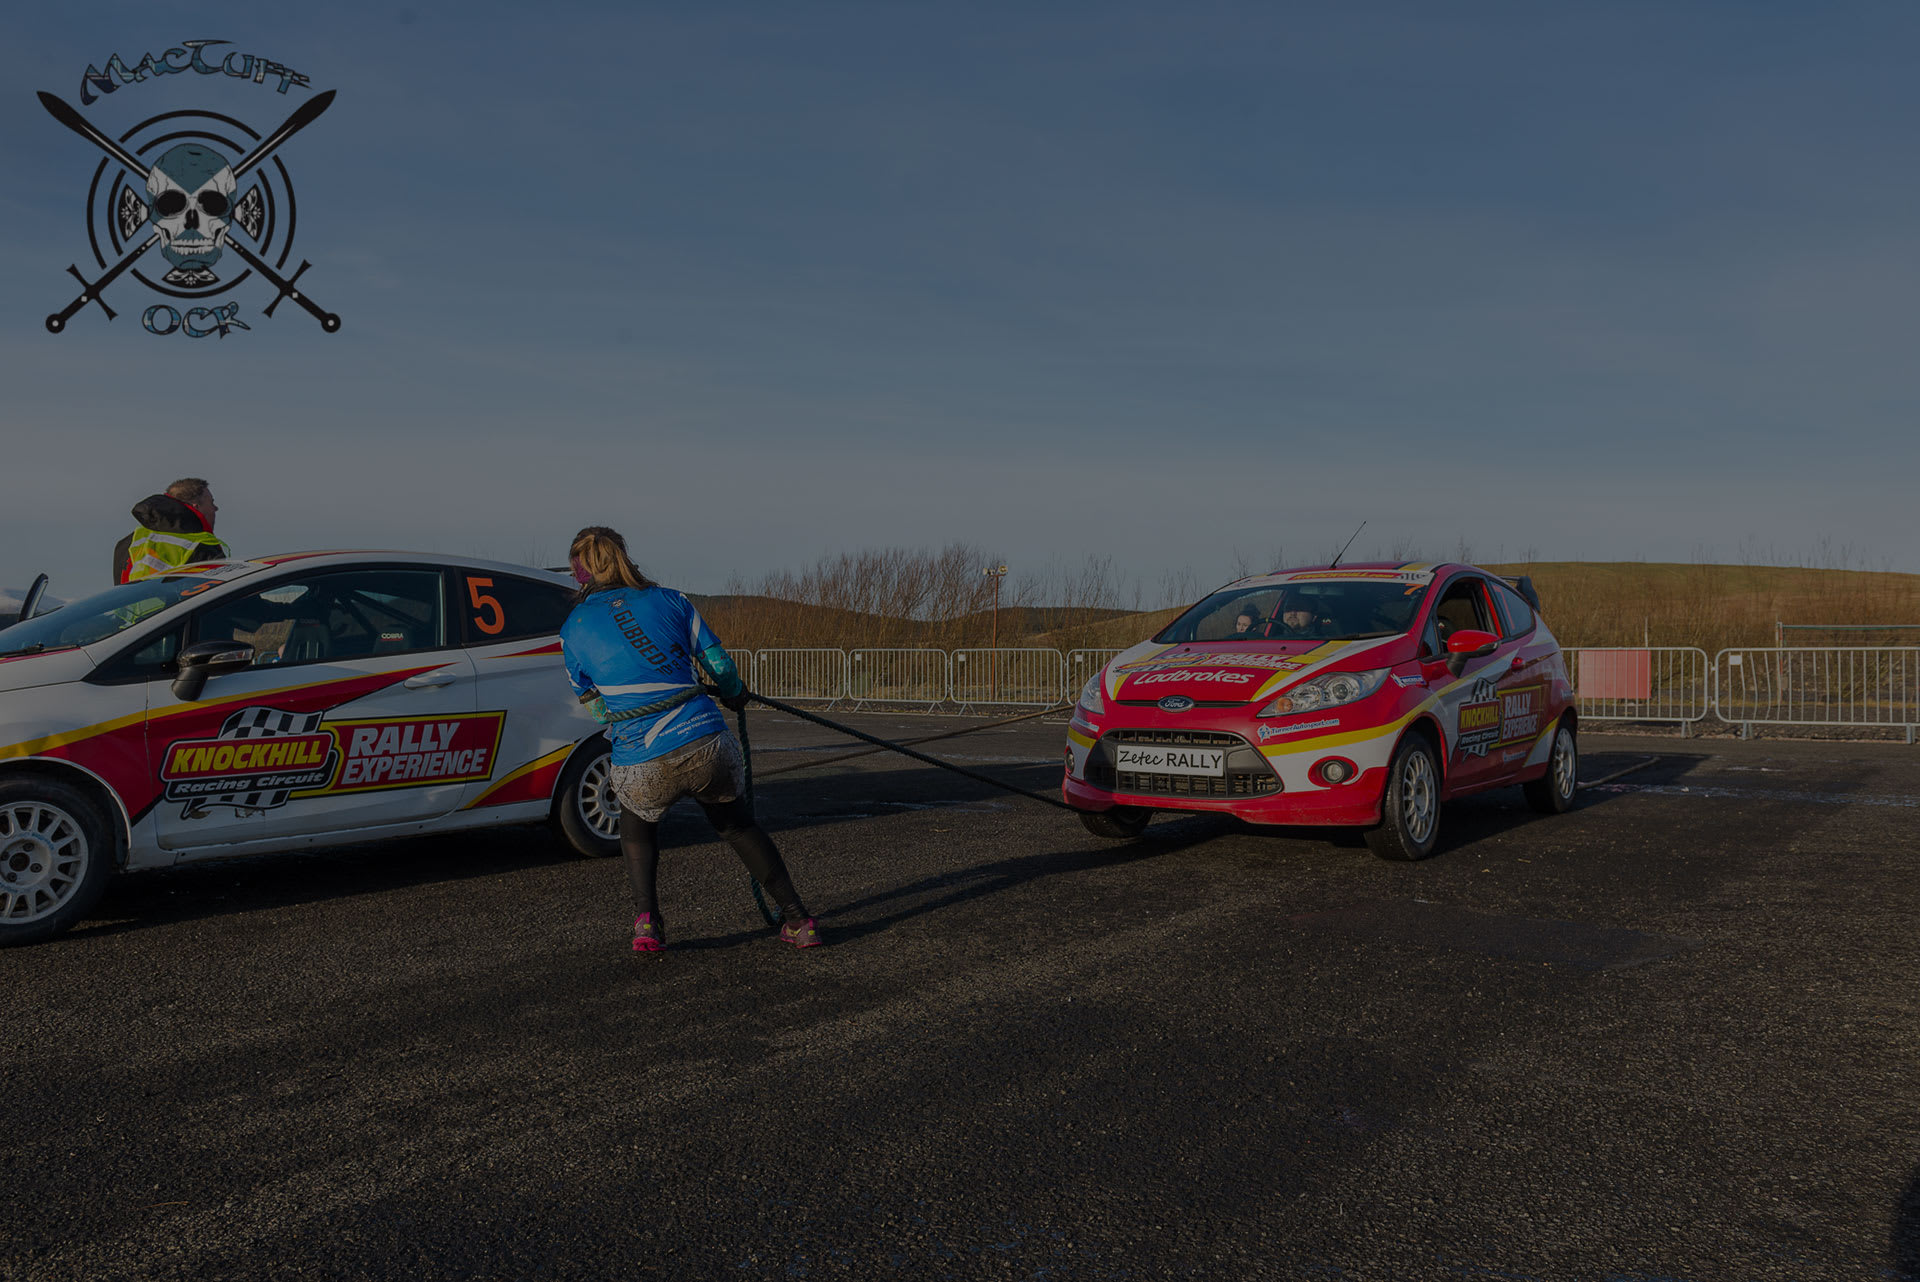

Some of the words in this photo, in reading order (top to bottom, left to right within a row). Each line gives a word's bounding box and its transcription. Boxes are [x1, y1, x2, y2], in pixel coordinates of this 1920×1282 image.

[1403, 583, 1425, 596] 7
[466, 576, 506, 635] 5
[613, 609, 668, 665] GUBBED
[1133, 670, 1255, 685] Ladbrokes
[1164, 698, 1186, 708] Ford
[1504, 694, 1531, 719] RALLY
[1461, 705, 1498, 729] KNOCKHILL
[1502, 714, 1537, 739] EXPERIENCE
[348, 722, 460, 757] RALLY
[171, 741, 322, 773] KNOCKHILL
[341, 748, 488, 785] EXPERIENCE
[1119, 750, 1164, 766] Zetec
[1166, 753, 1222, 769] RALLY
[174, 779, 252, 794] Racing
[256, 772, 325, 787] Circuit
